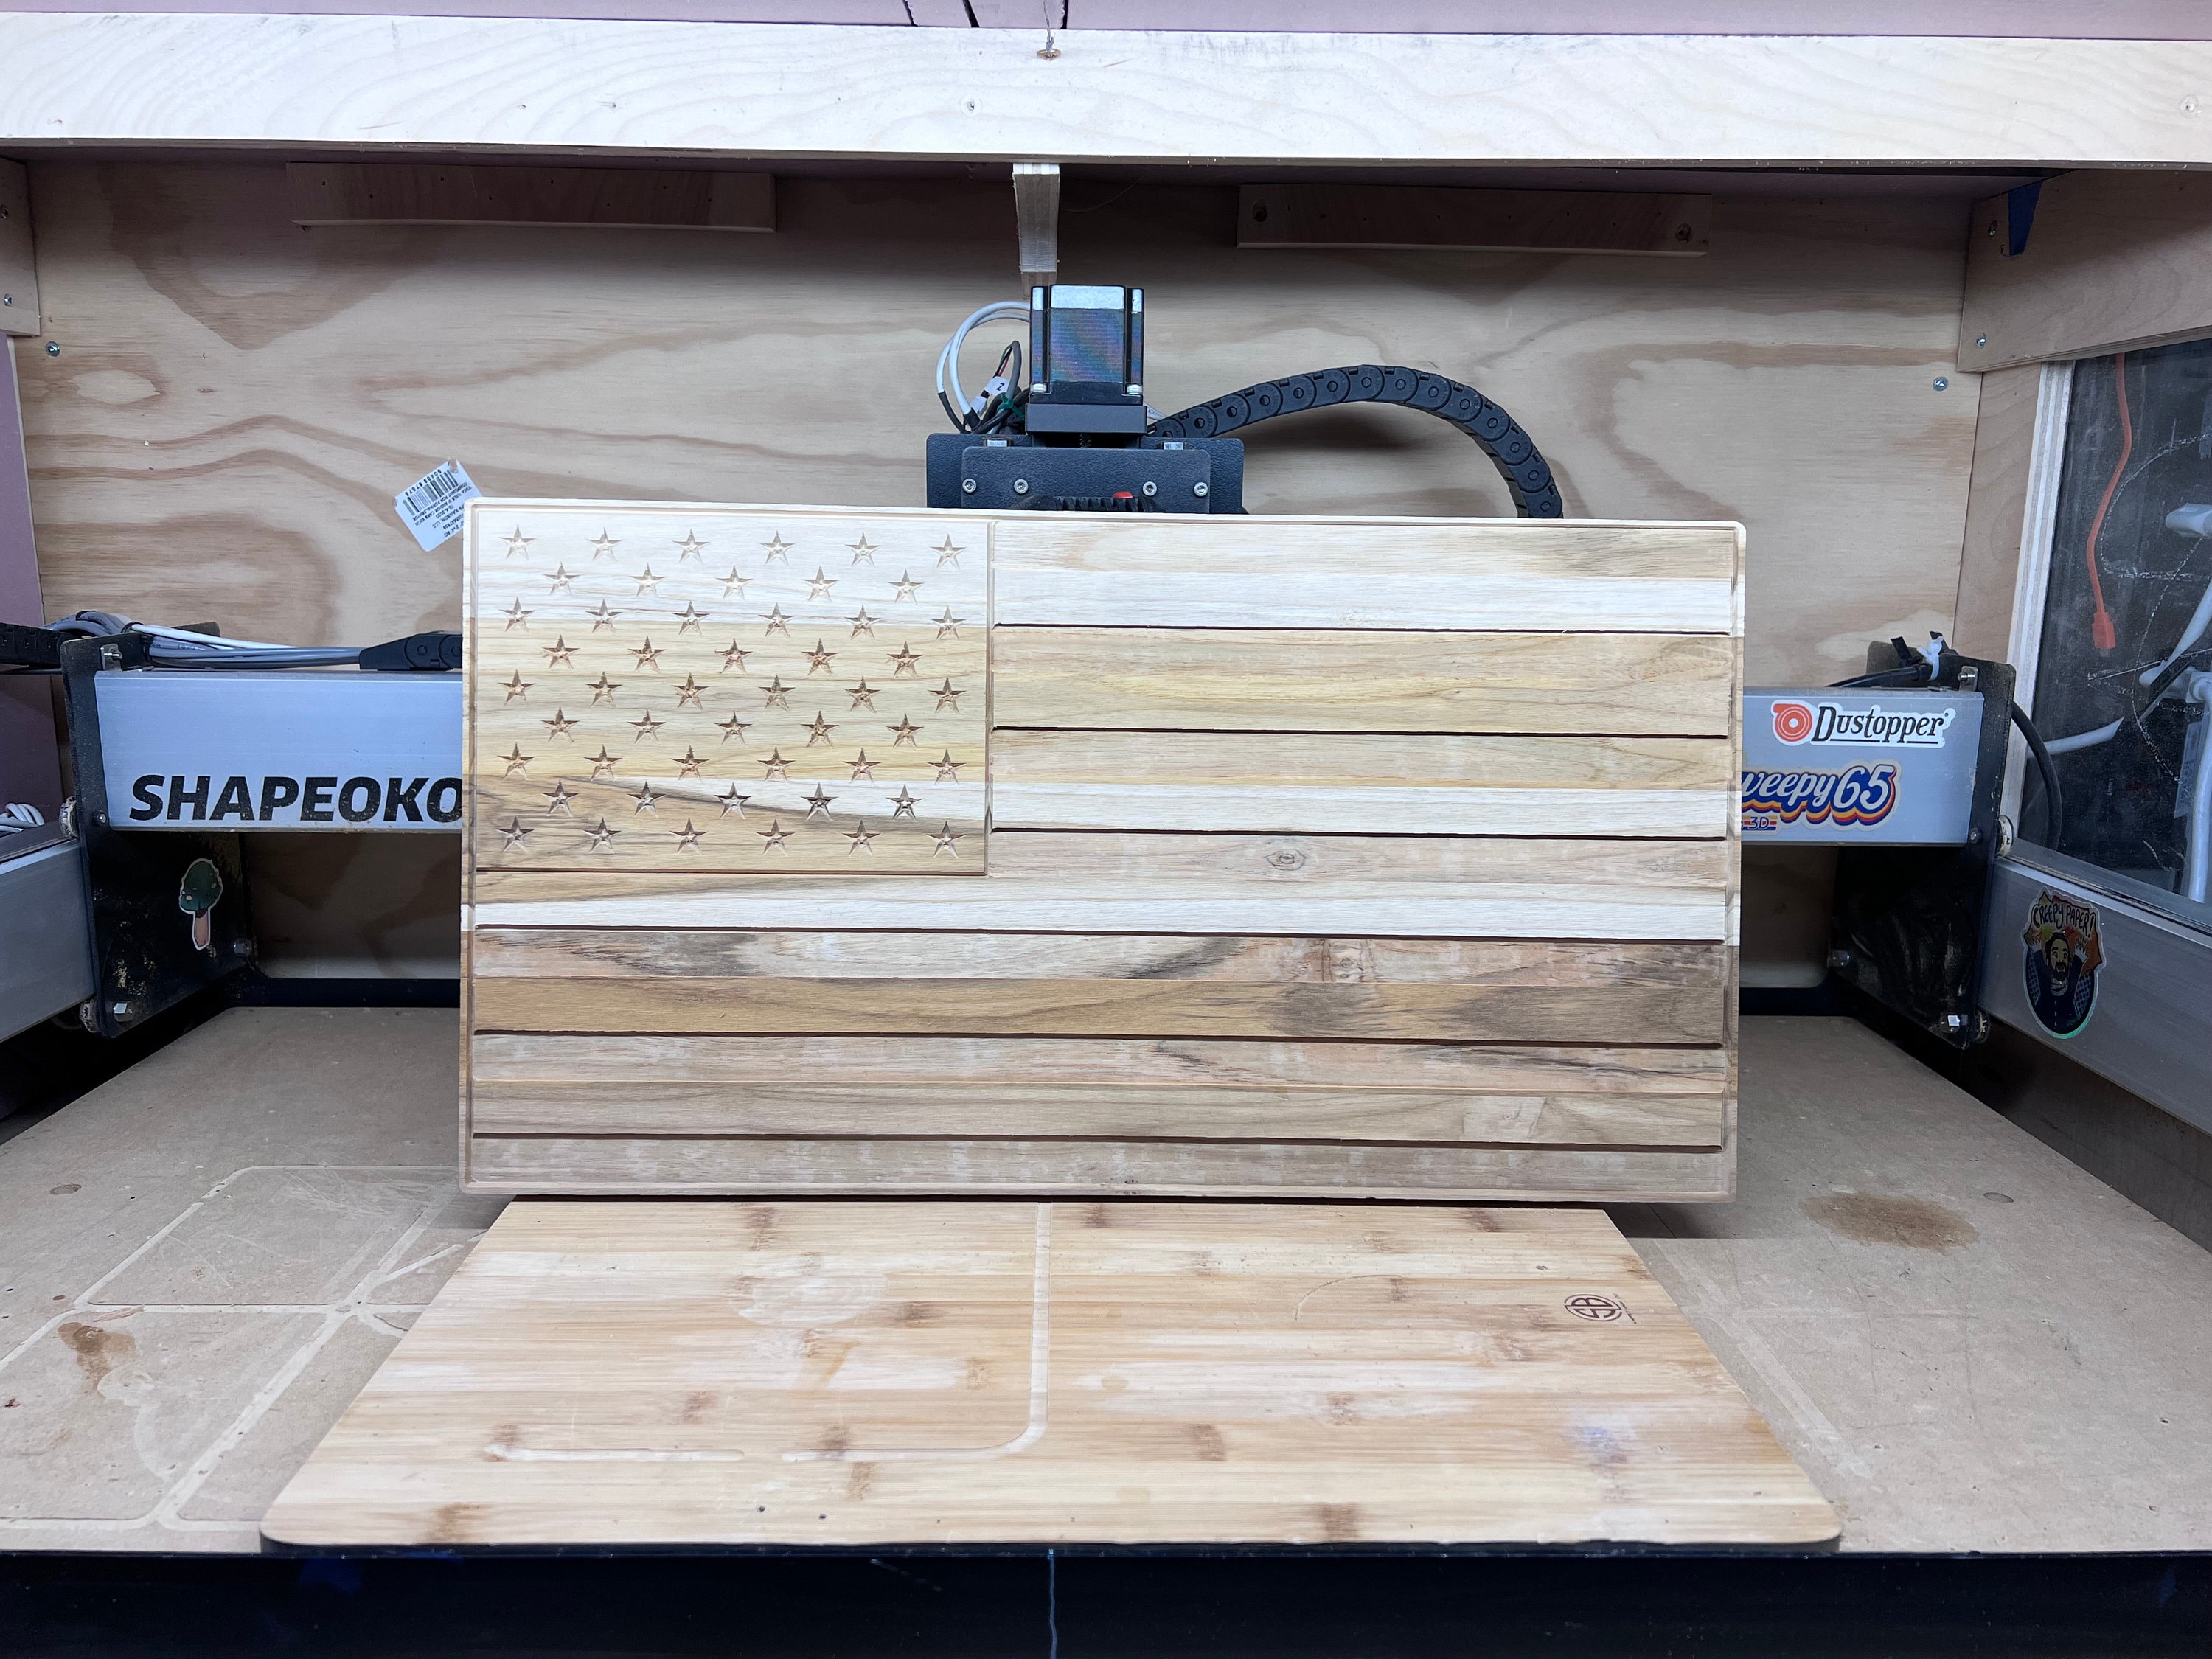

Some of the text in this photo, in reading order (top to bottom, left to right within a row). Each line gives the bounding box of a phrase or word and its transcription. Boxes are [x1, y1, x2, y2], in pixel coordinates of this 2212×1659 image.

[1812, 706, 1944, 743] Dustopper
[129, 774, 462, 822] SHAPEOKO
[1742, 764, 1893, 810] weepy65
[1748, 816, 1770, 829] 3D
[2033, 904, 2094, 938] CREEPY PAPER!
